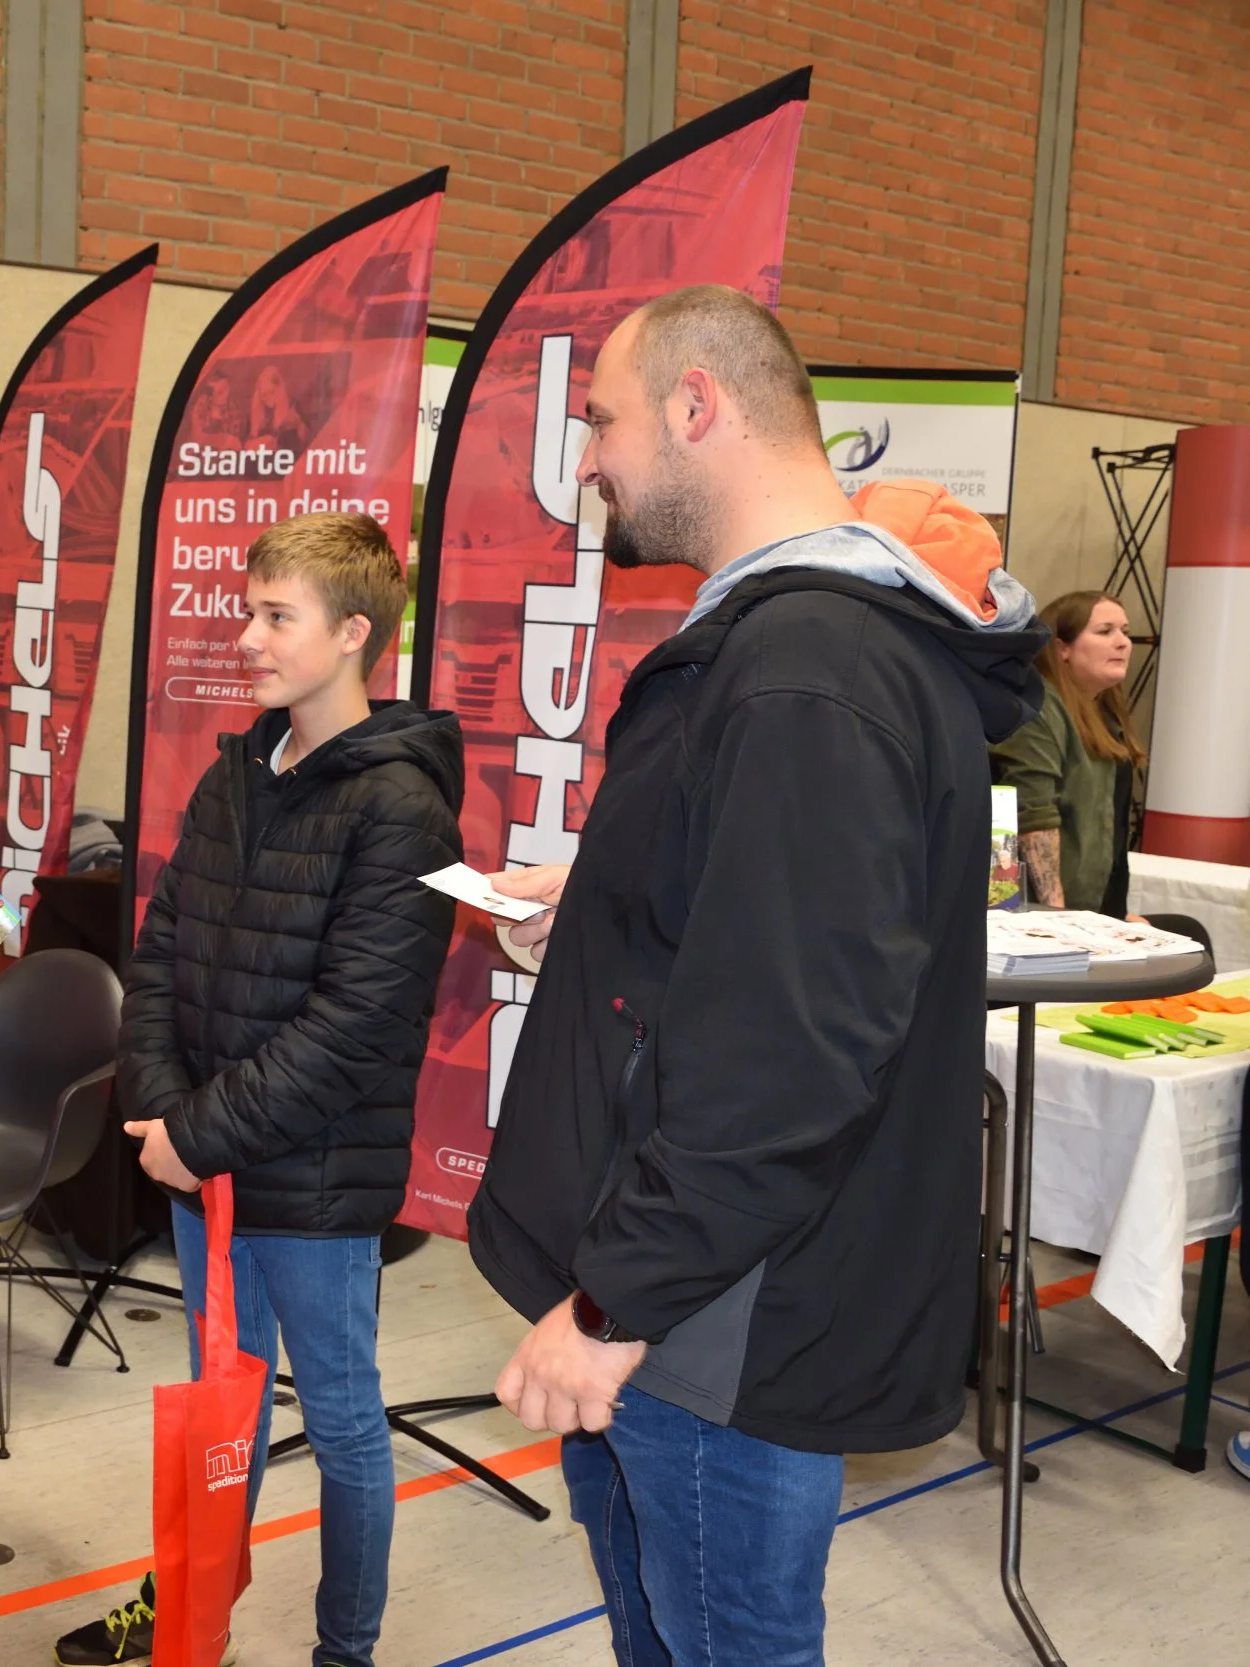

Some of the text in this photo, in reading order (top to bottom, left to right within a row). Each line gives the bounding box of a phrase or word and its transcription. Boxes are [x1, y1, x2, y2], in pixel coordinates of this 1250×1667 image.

[178, 439, 366, 476] Starte mit
[881, 466, 986, 479] DERNBACHER GRUPPE
[175, 497, 236, 524] uns
[247, 489, 278, 524] in
[167, 637, 208, 650] Einfach
[209, 641, 230, 652] per
[166, 654, 189, 667] Alle
[192, 657, 240, 670] weiteren
[195, 684, 254, 699] MICHELS
[447, 1155, 486, 1173] SPED
[414, 1188, 432, 1201] Karl
[433, 1193, 463, 1209] Michels
